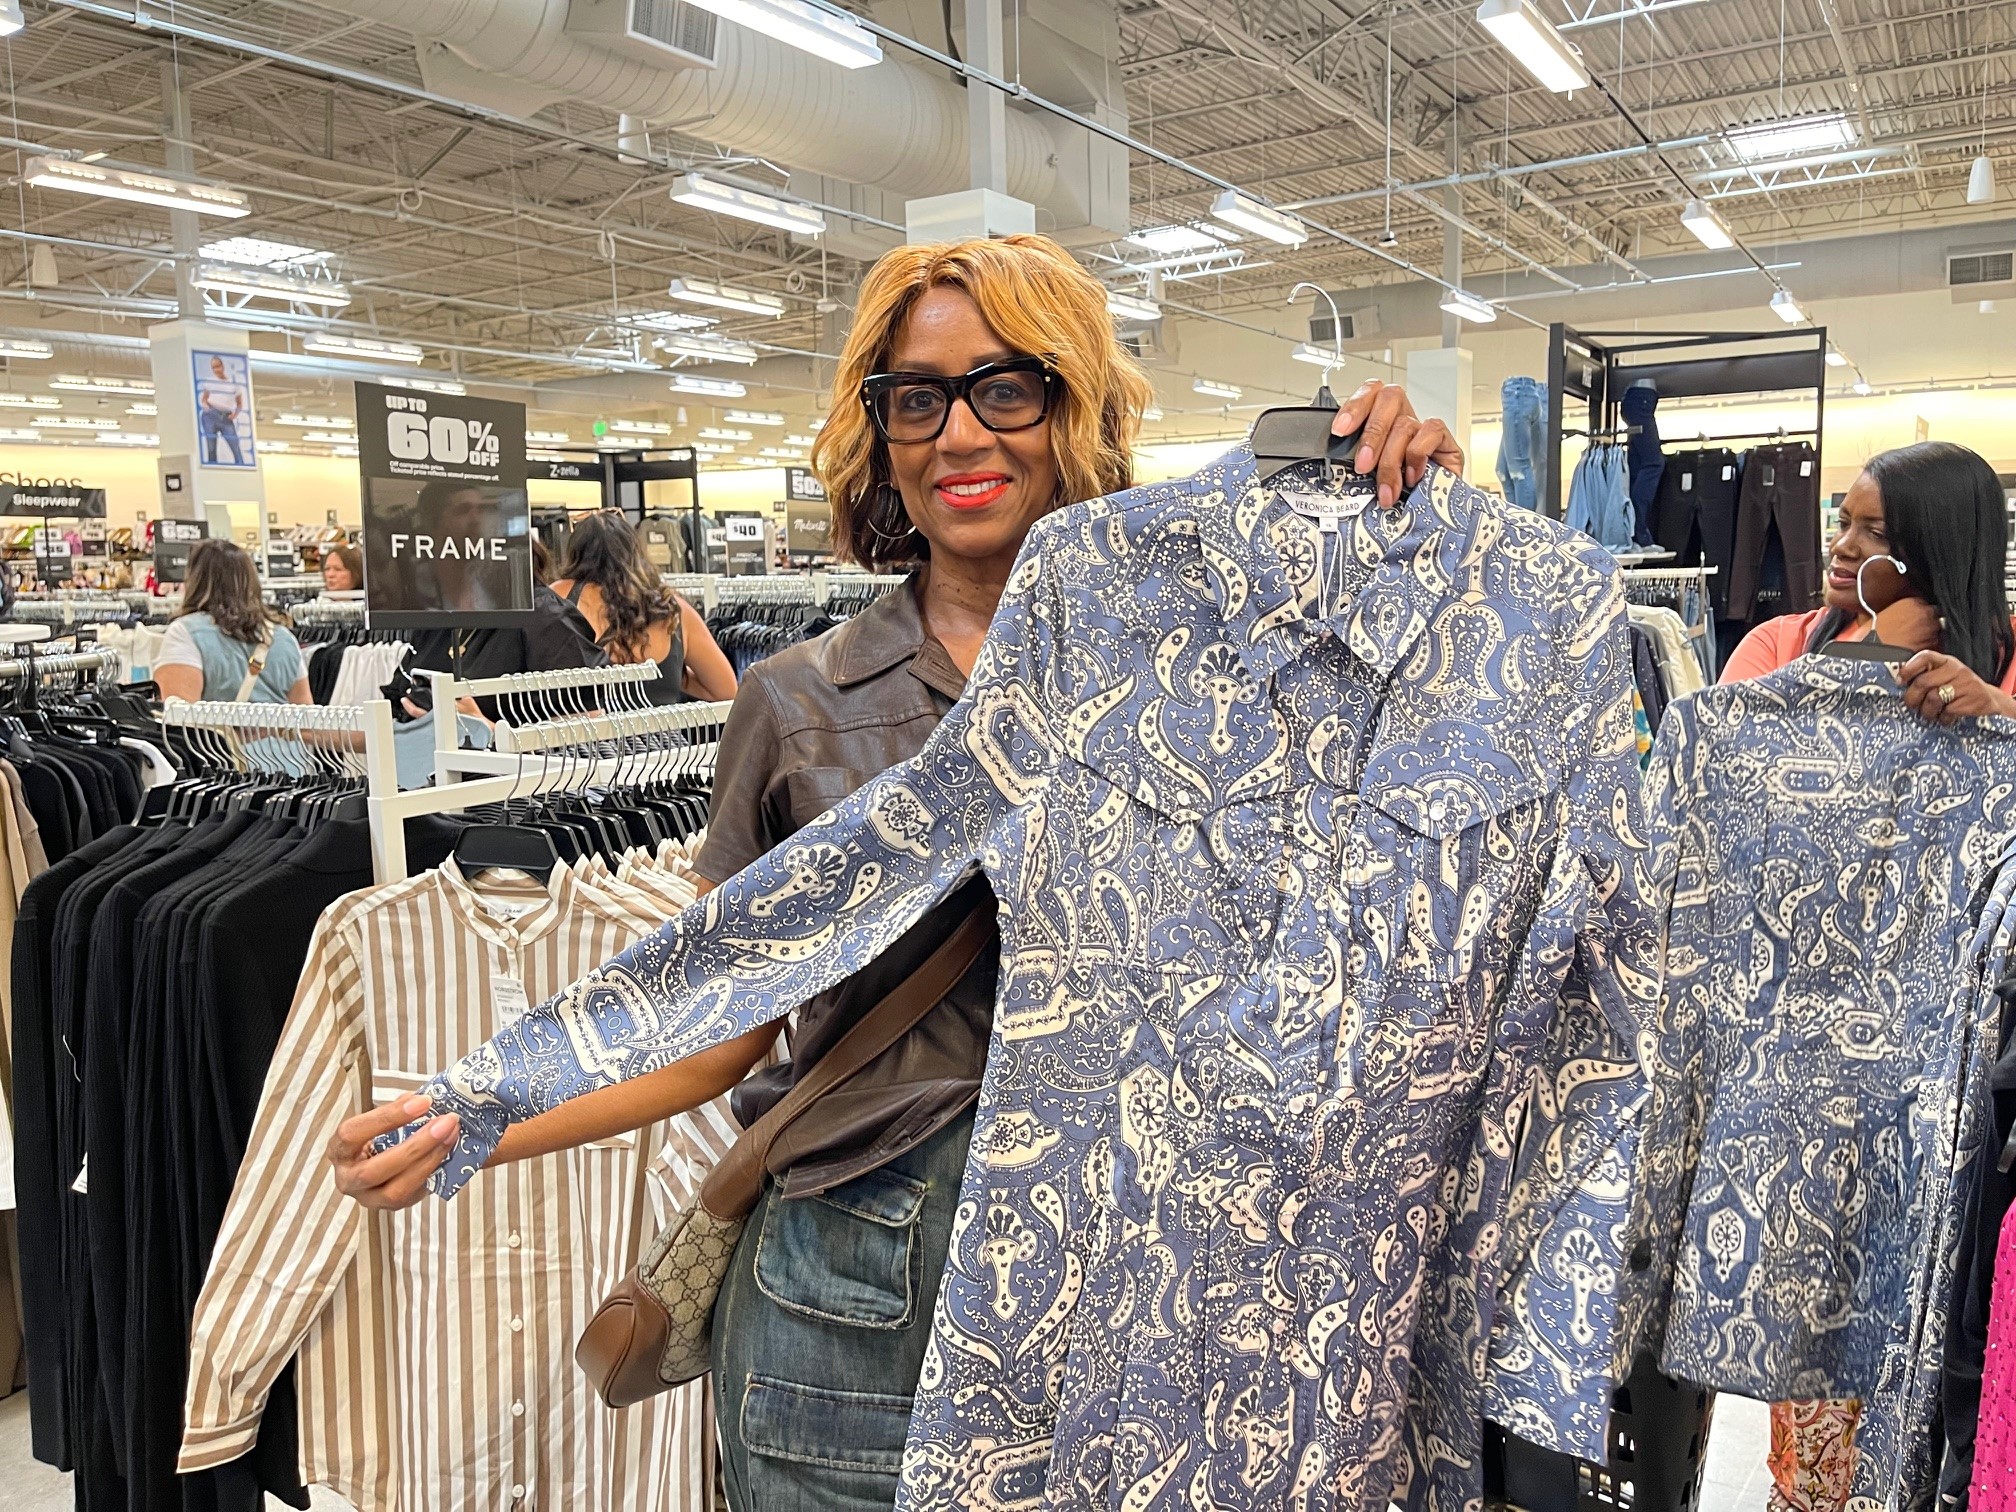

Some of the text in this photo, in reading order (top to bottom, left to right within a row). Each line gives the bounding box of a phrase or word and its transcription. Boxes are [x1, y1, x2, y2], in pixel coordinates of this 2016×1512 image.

[386, 395, 427, 413] UP TO
[387, 411, 499, 464] 60%
[469, 450, 499, 467] OFF
[13, 493, 81, 509] Sleepwear
[1295, 500, 1360, 513] VERONICA BEARD
[733, 525, 756, 536] $40
[391, 533, 508, 561] FRAME
